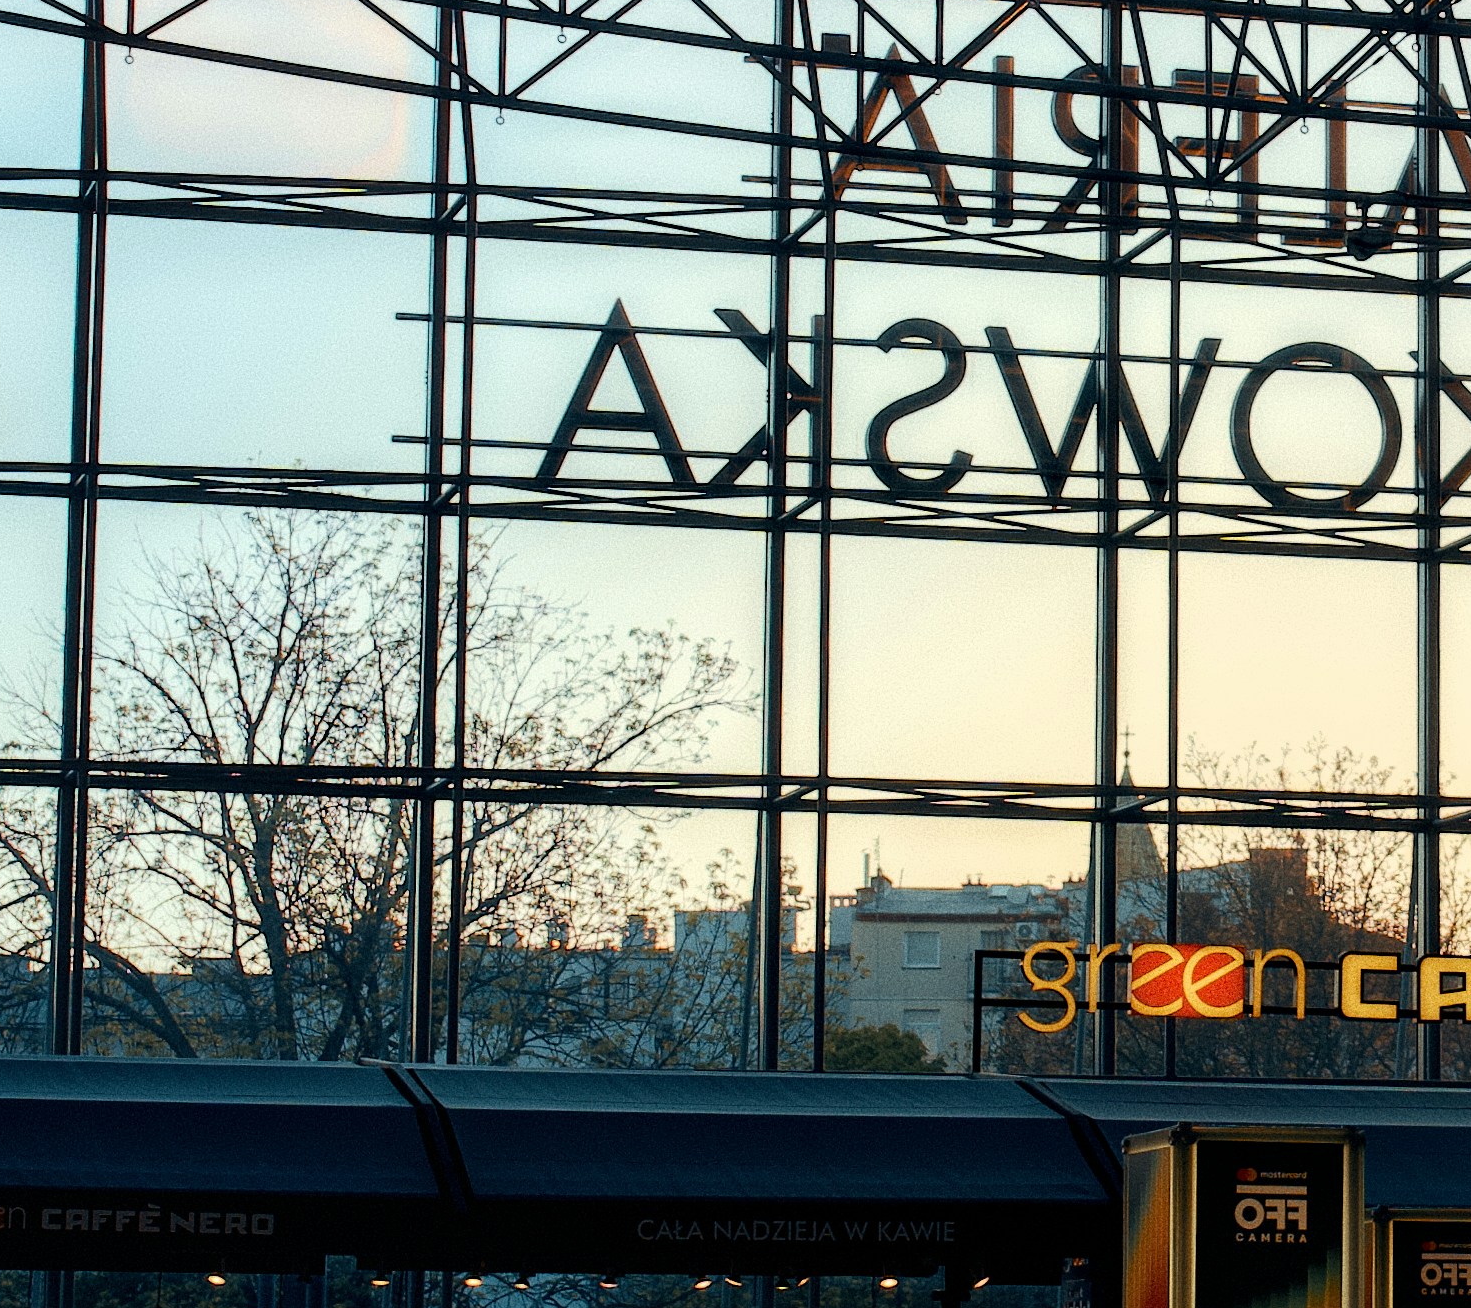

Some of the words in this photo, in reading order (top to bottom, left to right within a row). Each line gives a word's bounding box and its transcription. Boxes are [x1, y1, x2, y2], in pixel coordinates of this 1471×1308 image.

[1016, 937, 1306, 1033] green
[40, 1202, 162, 1234] CAFFÈ
[169, 1211, 276, 1236] NERO
[636, 1219, 705, 1242] CAŁA
[713, 1219, 836, 1243] NADZIEJA
[843, 1220, 869, 1243] W
[878, 1220, 956, 1243] KAWIE
[1234, 1198, 1308, 1231] OFF
[1235, 1232, 1308, 1244] CAMERA
